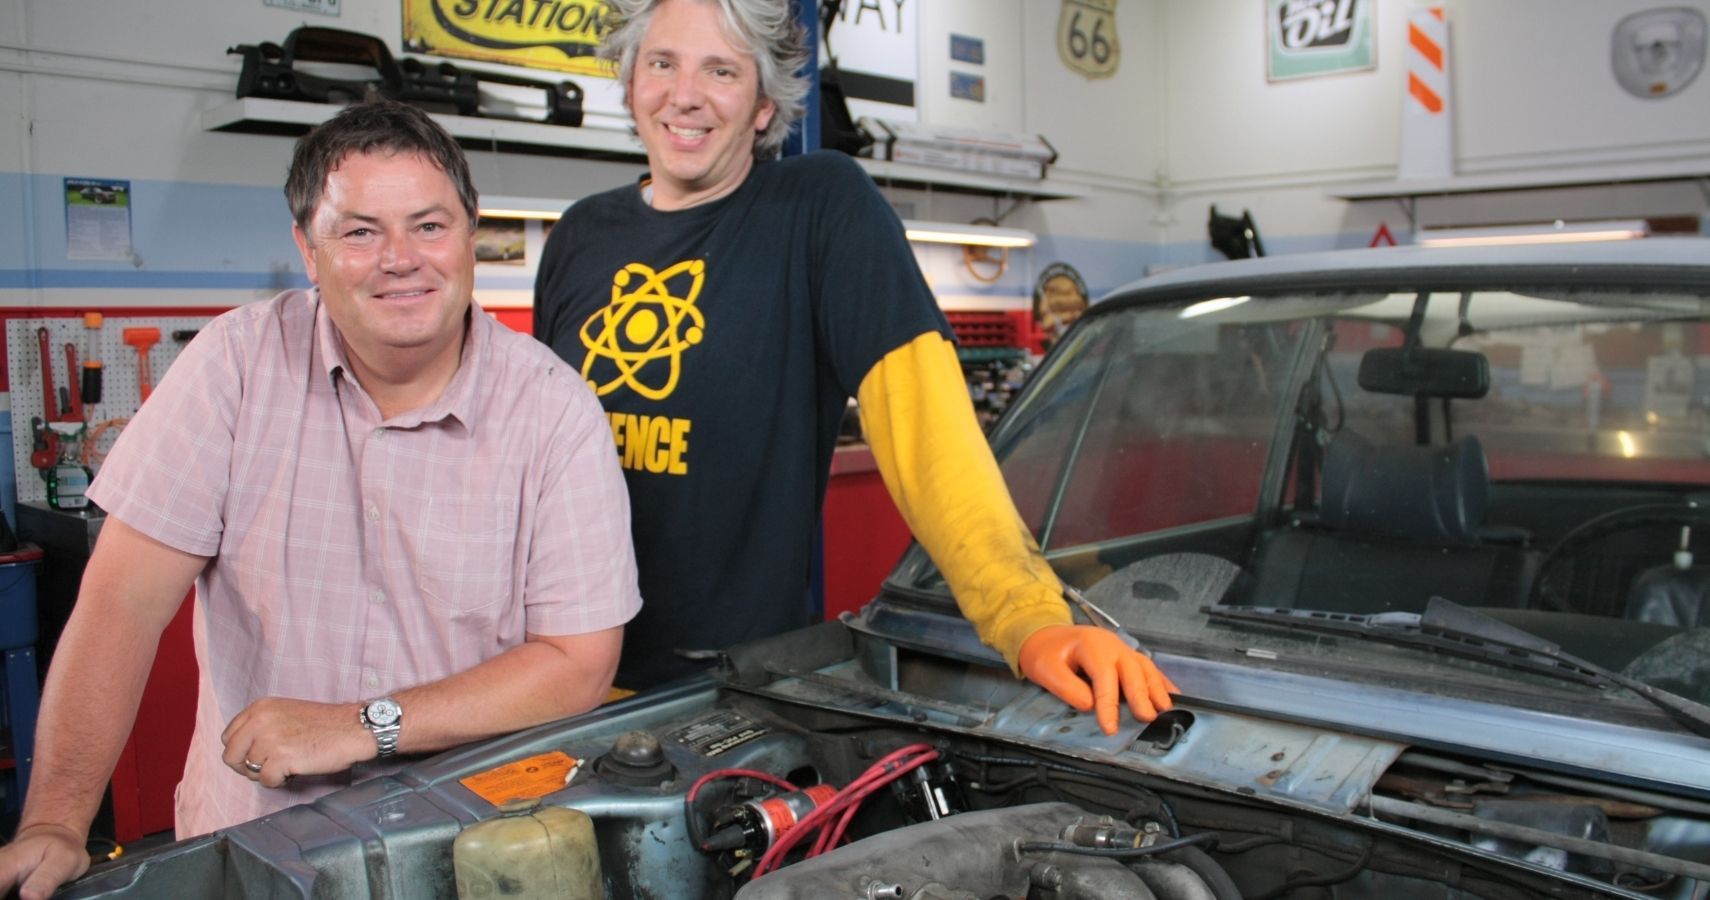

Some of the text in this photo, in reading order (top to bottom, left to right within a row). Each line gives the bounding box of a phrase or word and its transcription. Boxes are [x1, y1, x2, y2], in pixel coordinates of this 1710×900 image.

[453, 0, 608, 36] STATION
[838, 0, 905, 34] AY
[1068, 10, 1111, 65] 66
[605, 411, 691, 475] ENCE
